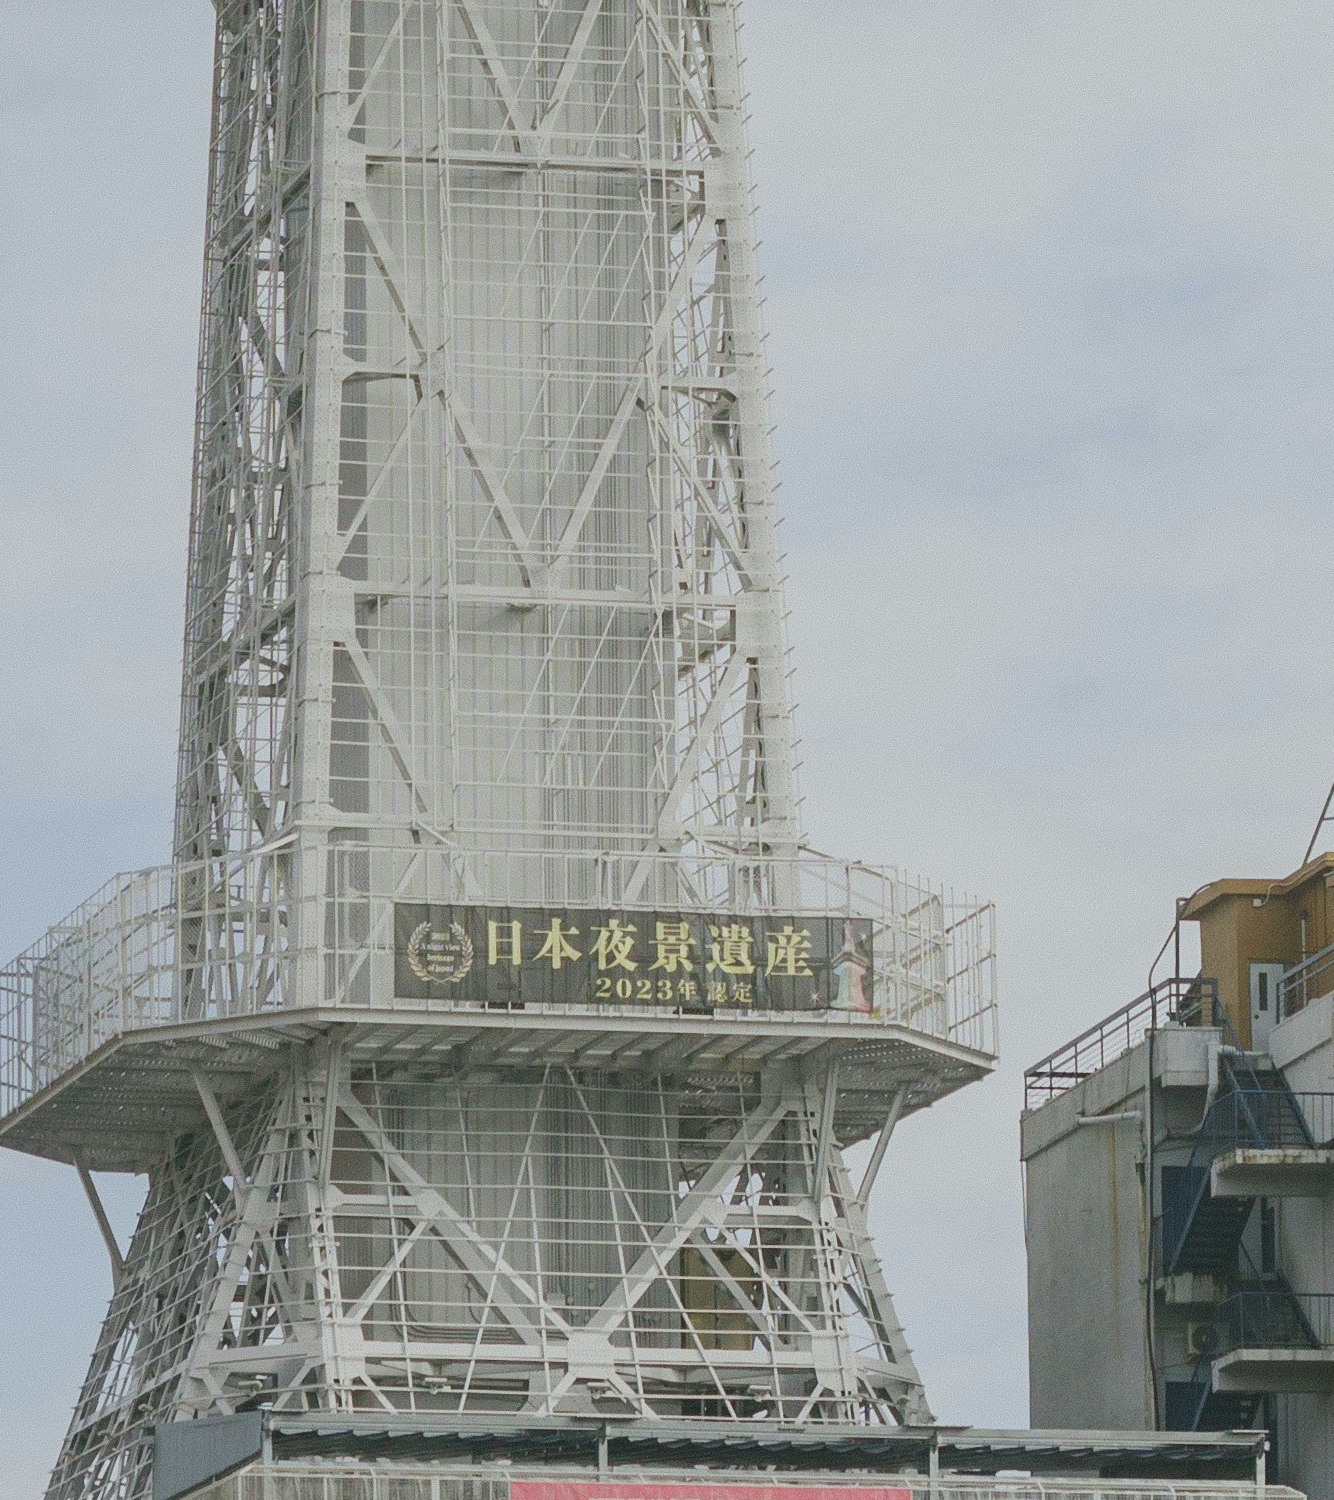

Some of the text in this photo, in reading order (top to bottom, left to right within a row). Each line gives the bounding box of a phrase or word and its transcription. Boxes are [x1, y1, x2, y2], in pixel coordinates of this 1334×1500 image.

[487, 917, 816, 978] 日本夜景遺産
[595, 977, 754, 1004] 2023年 認定
